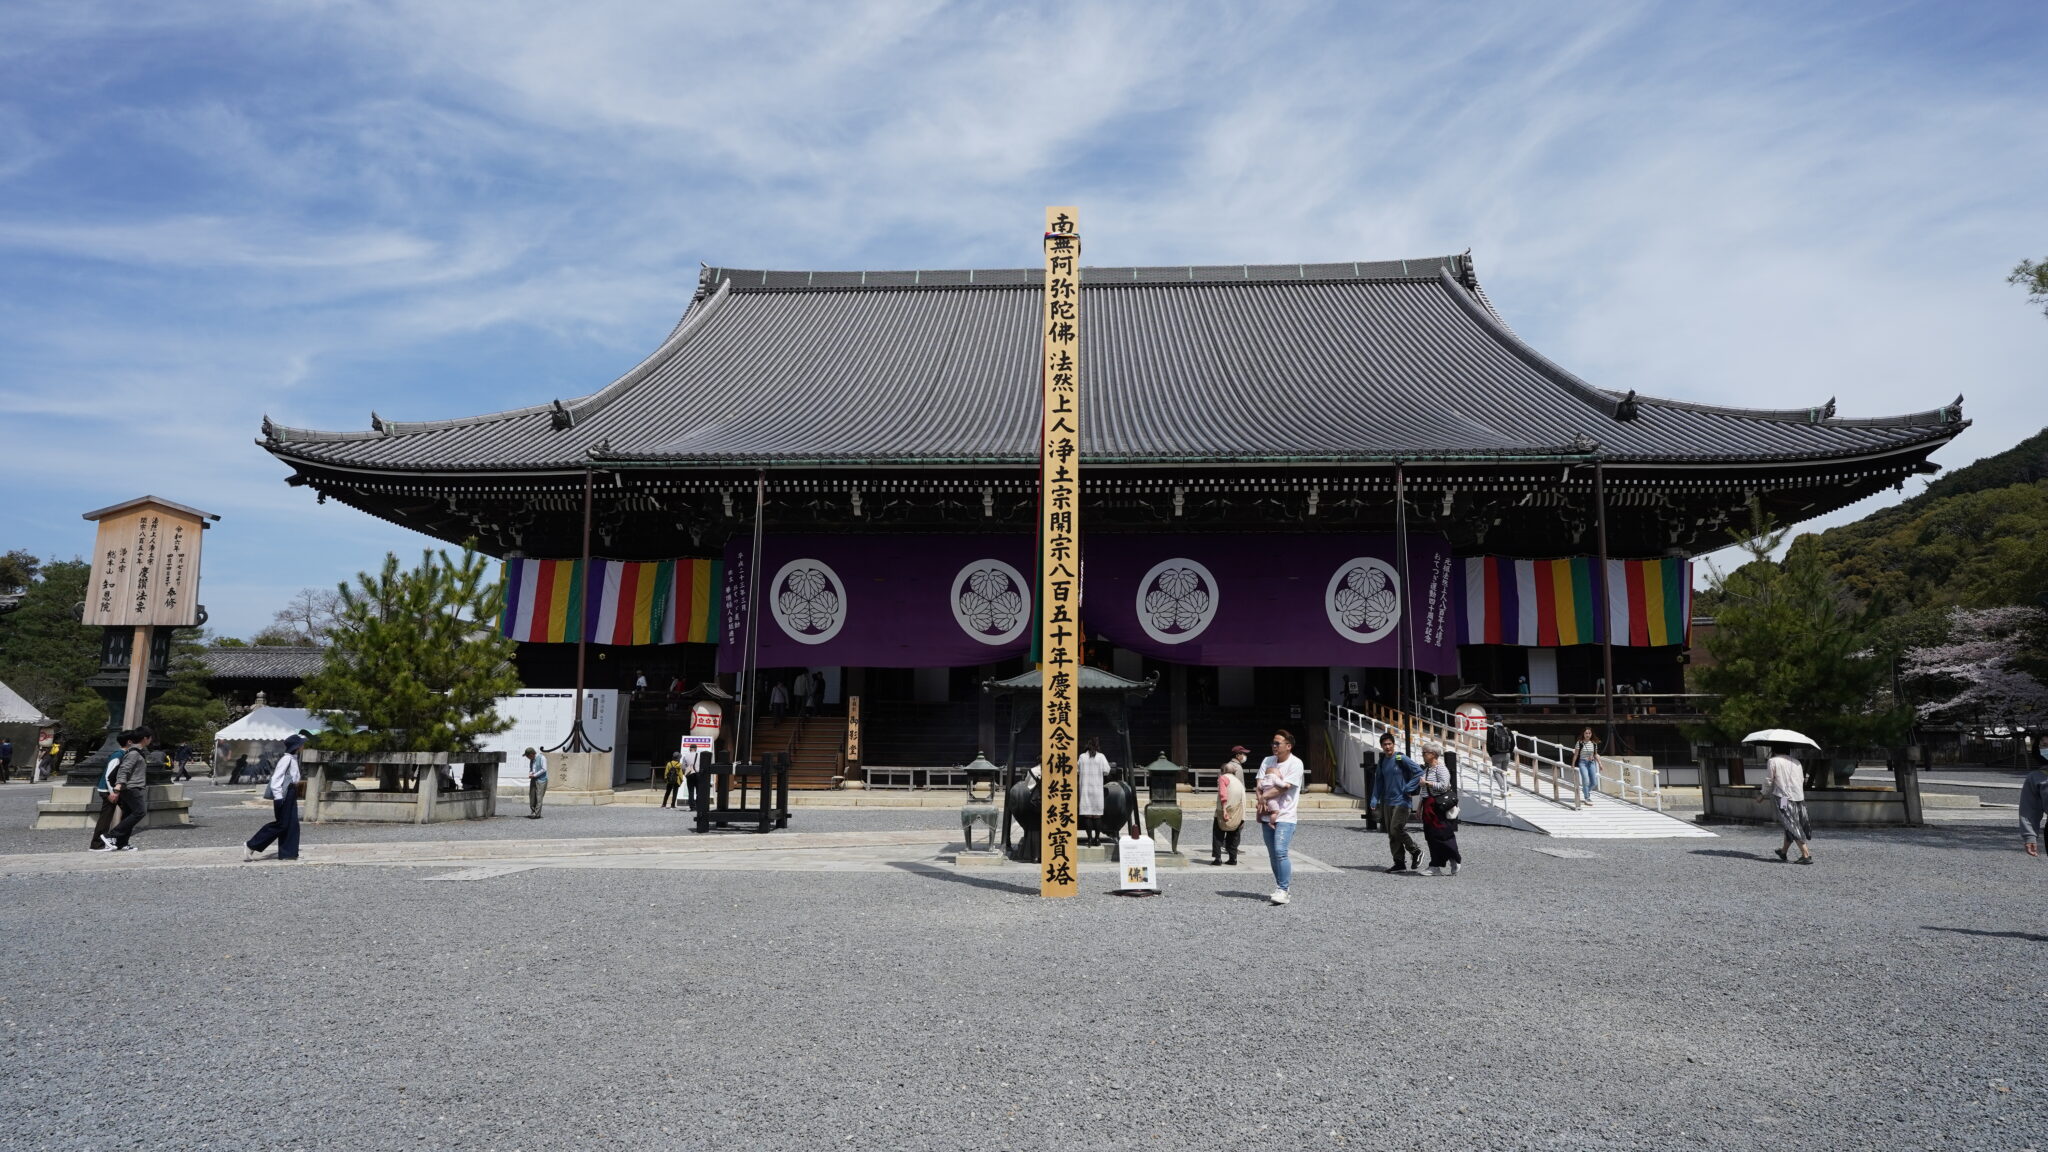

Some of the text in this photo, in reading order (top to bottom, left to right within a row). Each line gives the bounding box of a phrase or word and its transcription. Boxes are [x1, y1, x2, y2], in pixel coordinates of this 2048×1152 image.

[119, 547, 127, 573] 浄土宗
[100, 579, 115, 613] 知恩院
